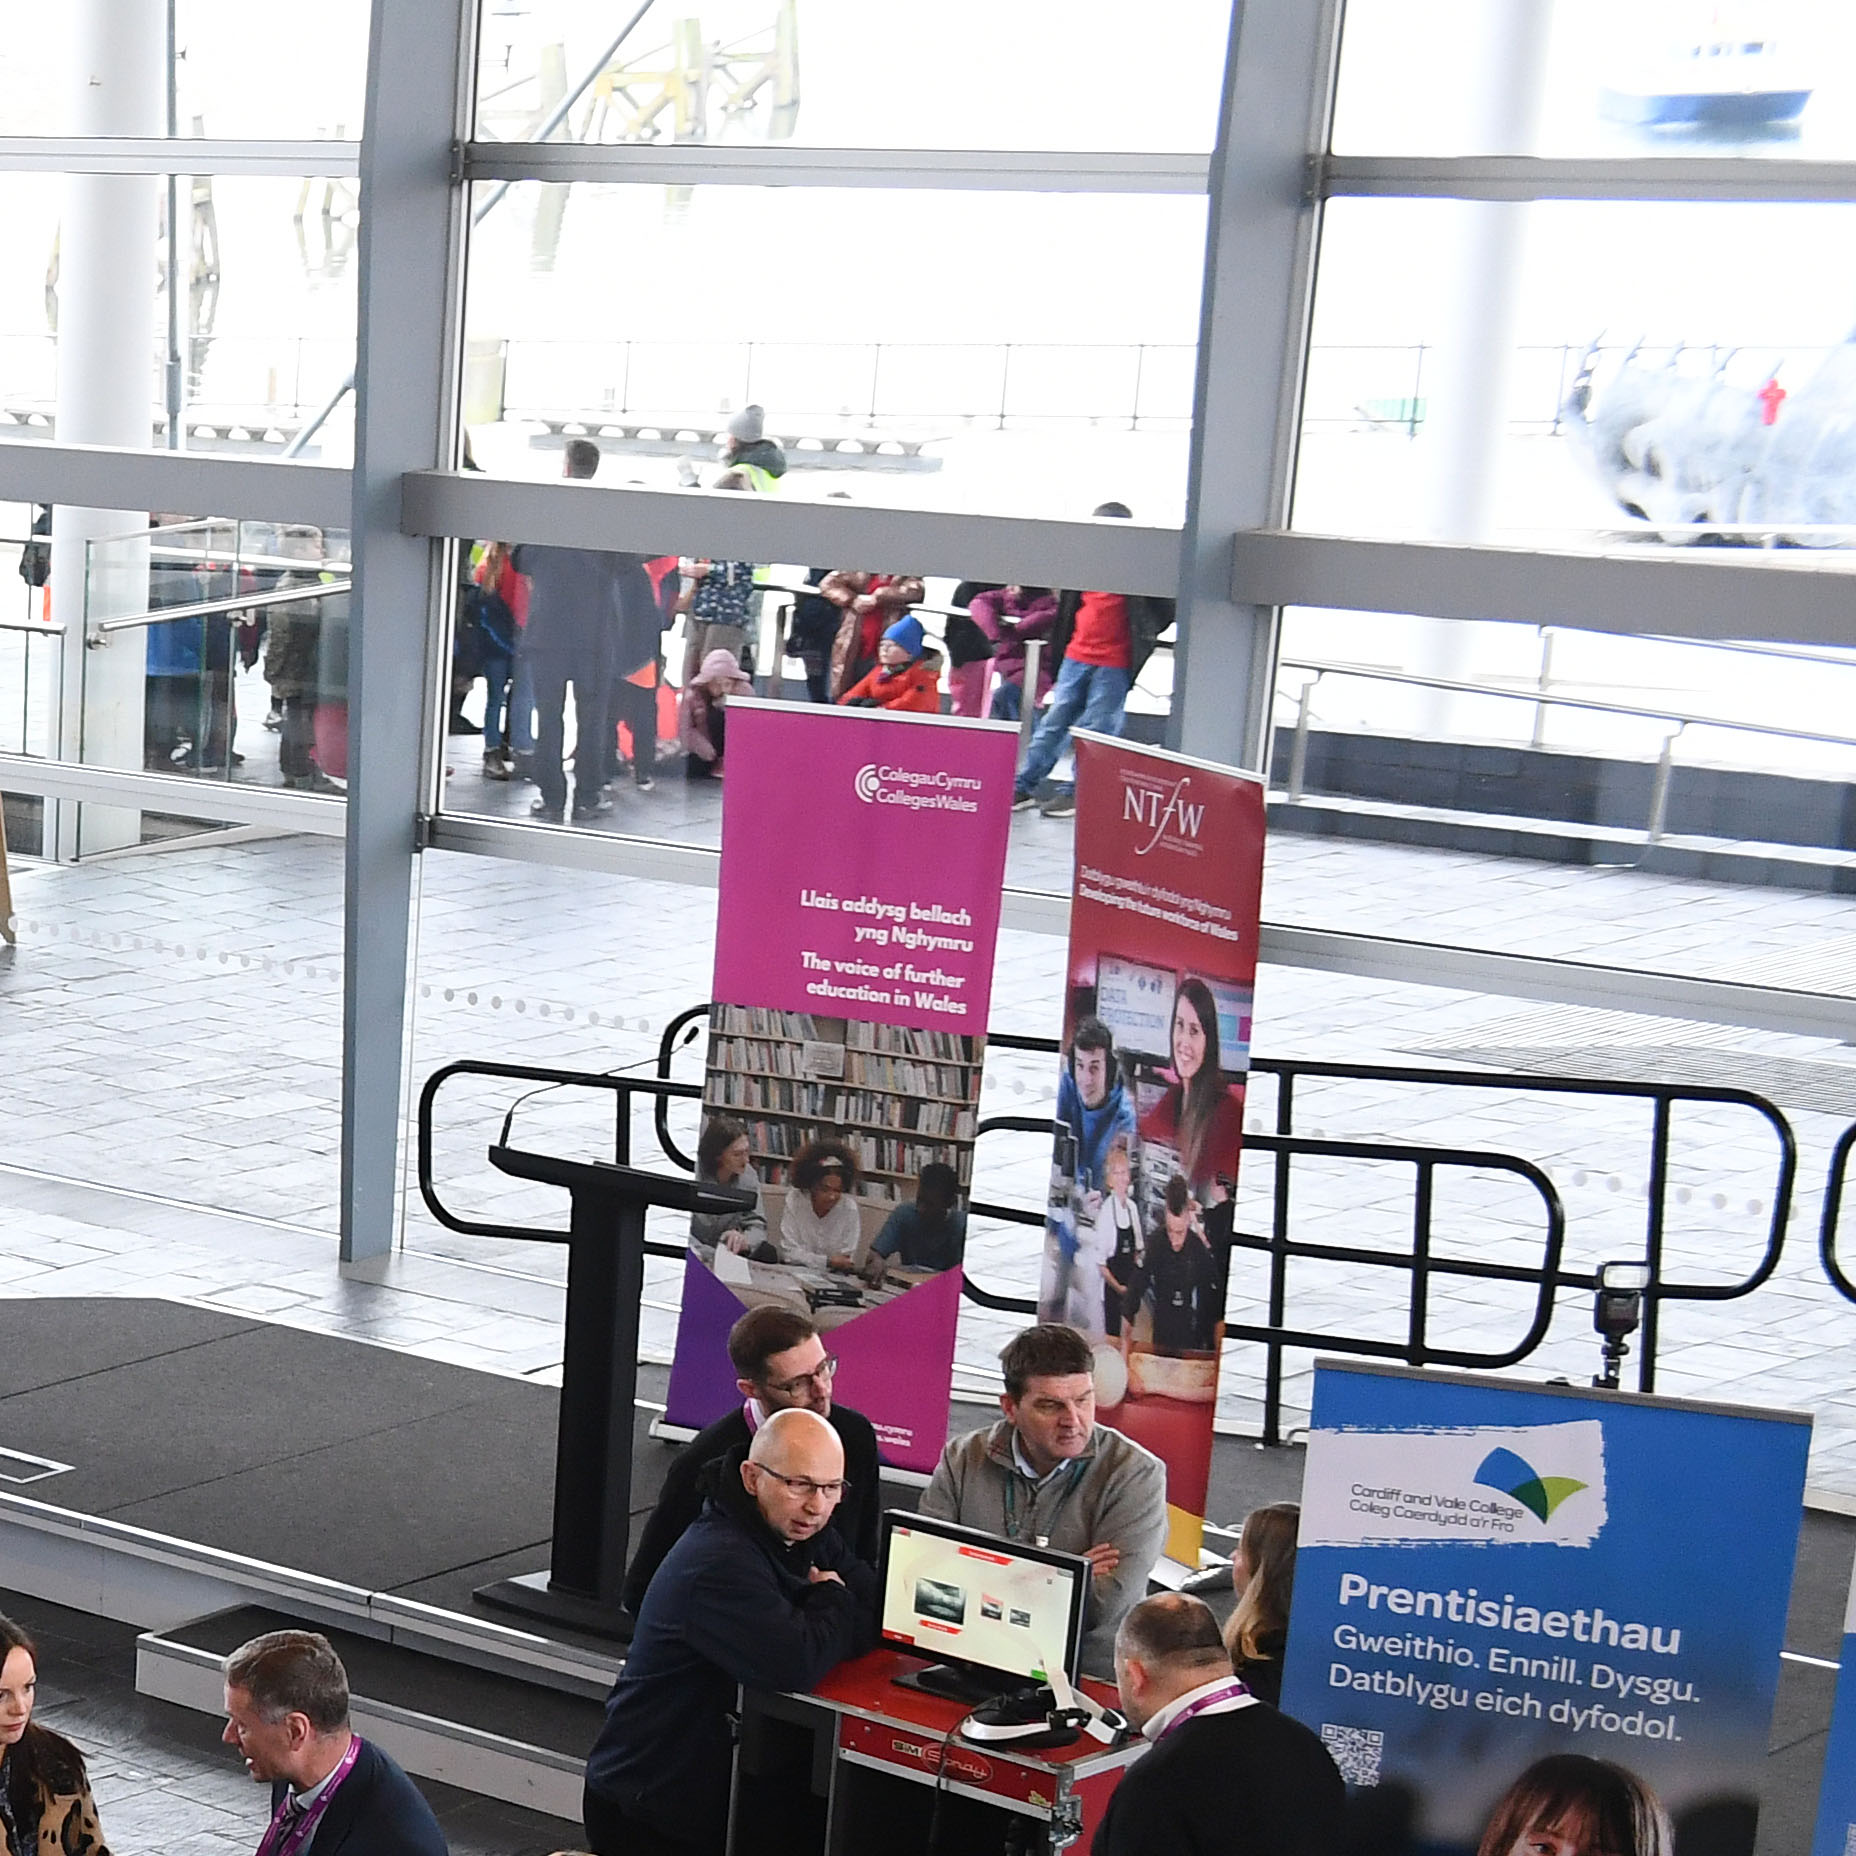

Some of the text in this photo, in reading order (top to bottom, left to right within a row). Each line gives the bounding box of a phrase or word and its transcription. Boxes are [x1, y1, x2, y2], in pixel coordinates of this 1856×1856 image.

[878, 766, 982, 790] ColegauCymru
[876, 789, 978, 812] CollegesWales
[801, 889, 972, 927] Llais addysg bellach
[854, 924, 974, 953] yng Nghymru
[801, 952, 966, 989] The voice of further
[806, 980, 968, 1015] education in Wales
[1349, 1499, 1515, 1533] Coleg Caerdydd a'r Fro
[1351, 1484, 1524, 1519] Cardiff and Vale College
[1339, 1572, 1682, 1655] Prentisiaethau
[1333, 1624, 1701, 1704] Gweithio. Ennill. Dysgu.
[1329, 1663, 1683, 1741] Datblygu eich dyfodol.
[892, 1740, 922, 1757] SIM
